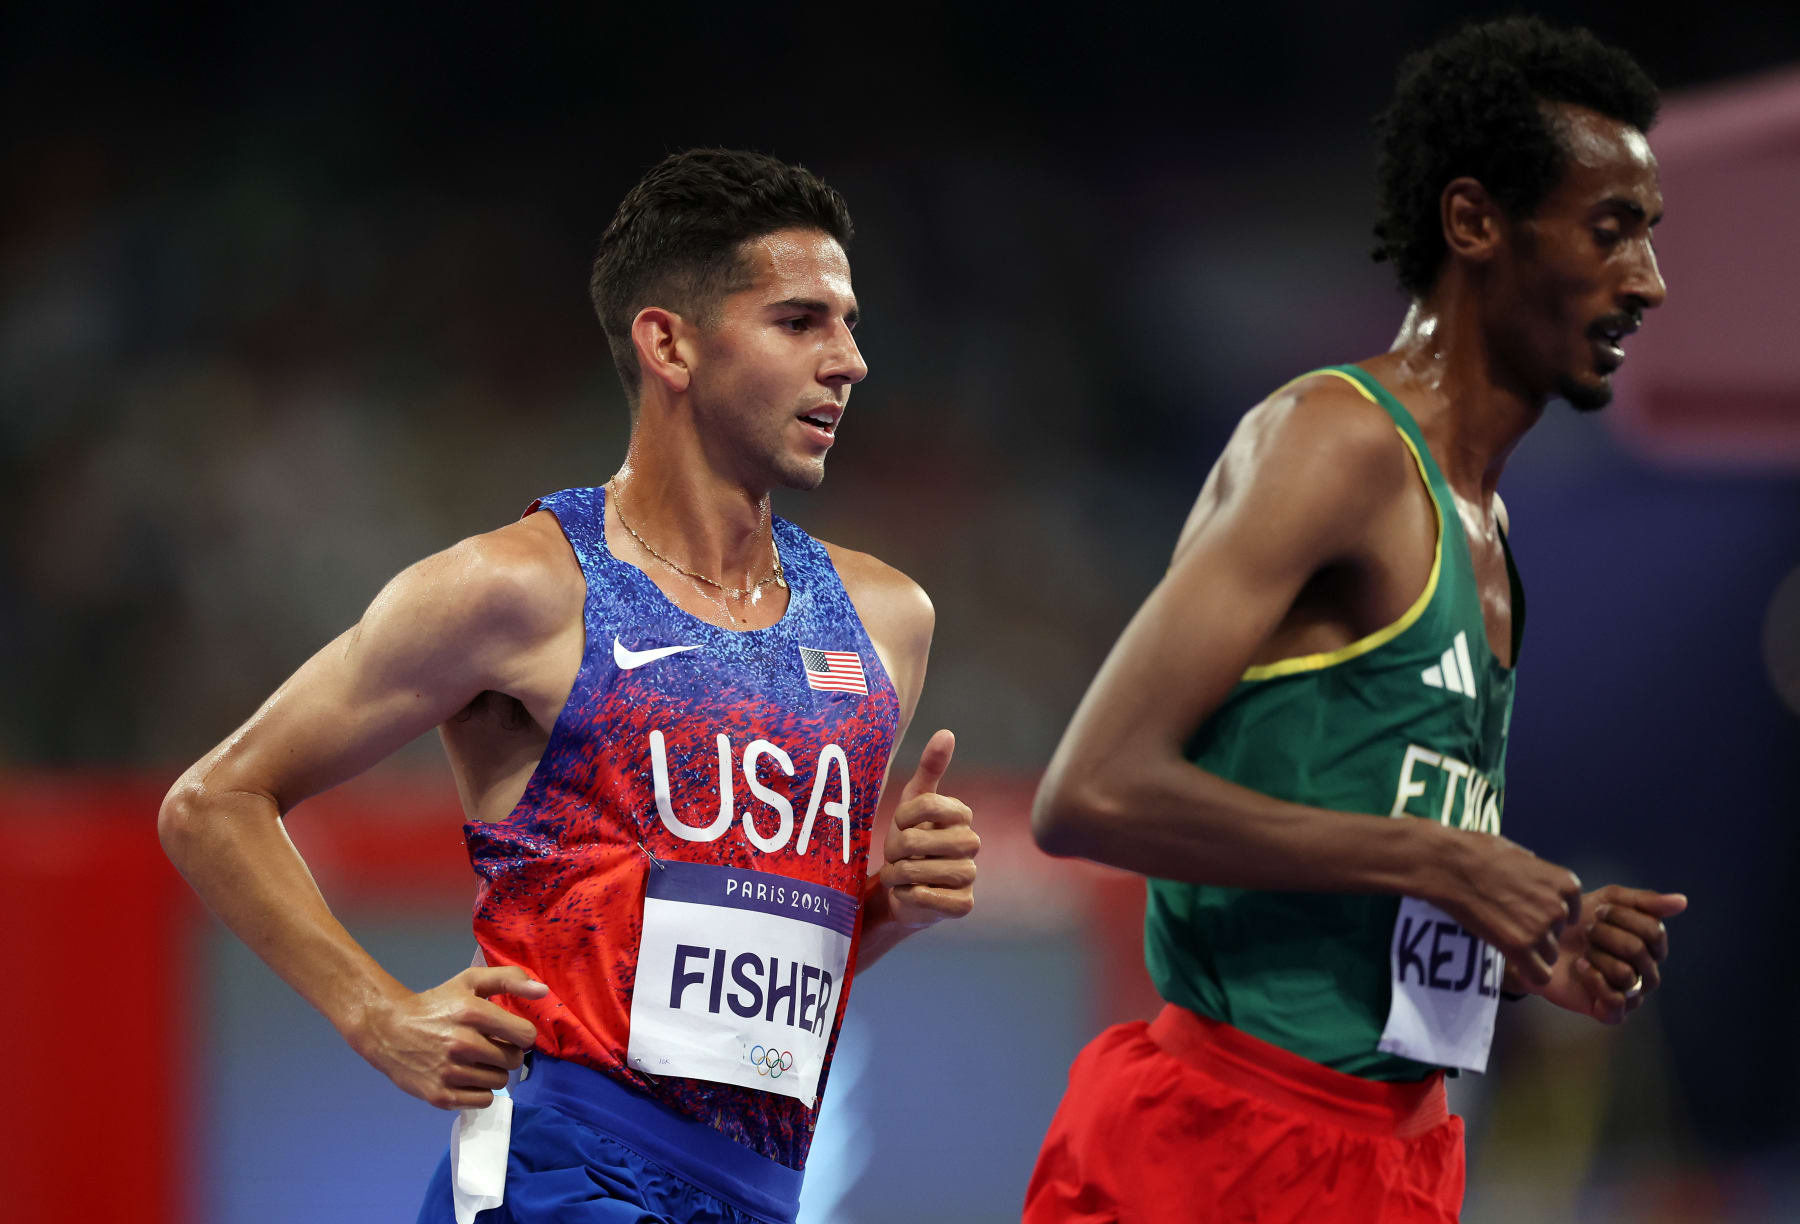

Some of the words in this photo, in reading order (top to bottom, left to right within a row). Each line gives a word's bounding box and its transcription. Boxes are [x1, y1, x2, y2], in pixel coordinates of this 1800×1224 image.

[649, 729, 850, 864] USA
[791, 890, 830, 916] 2024
[669, 943, 833, 1038] FISHER
